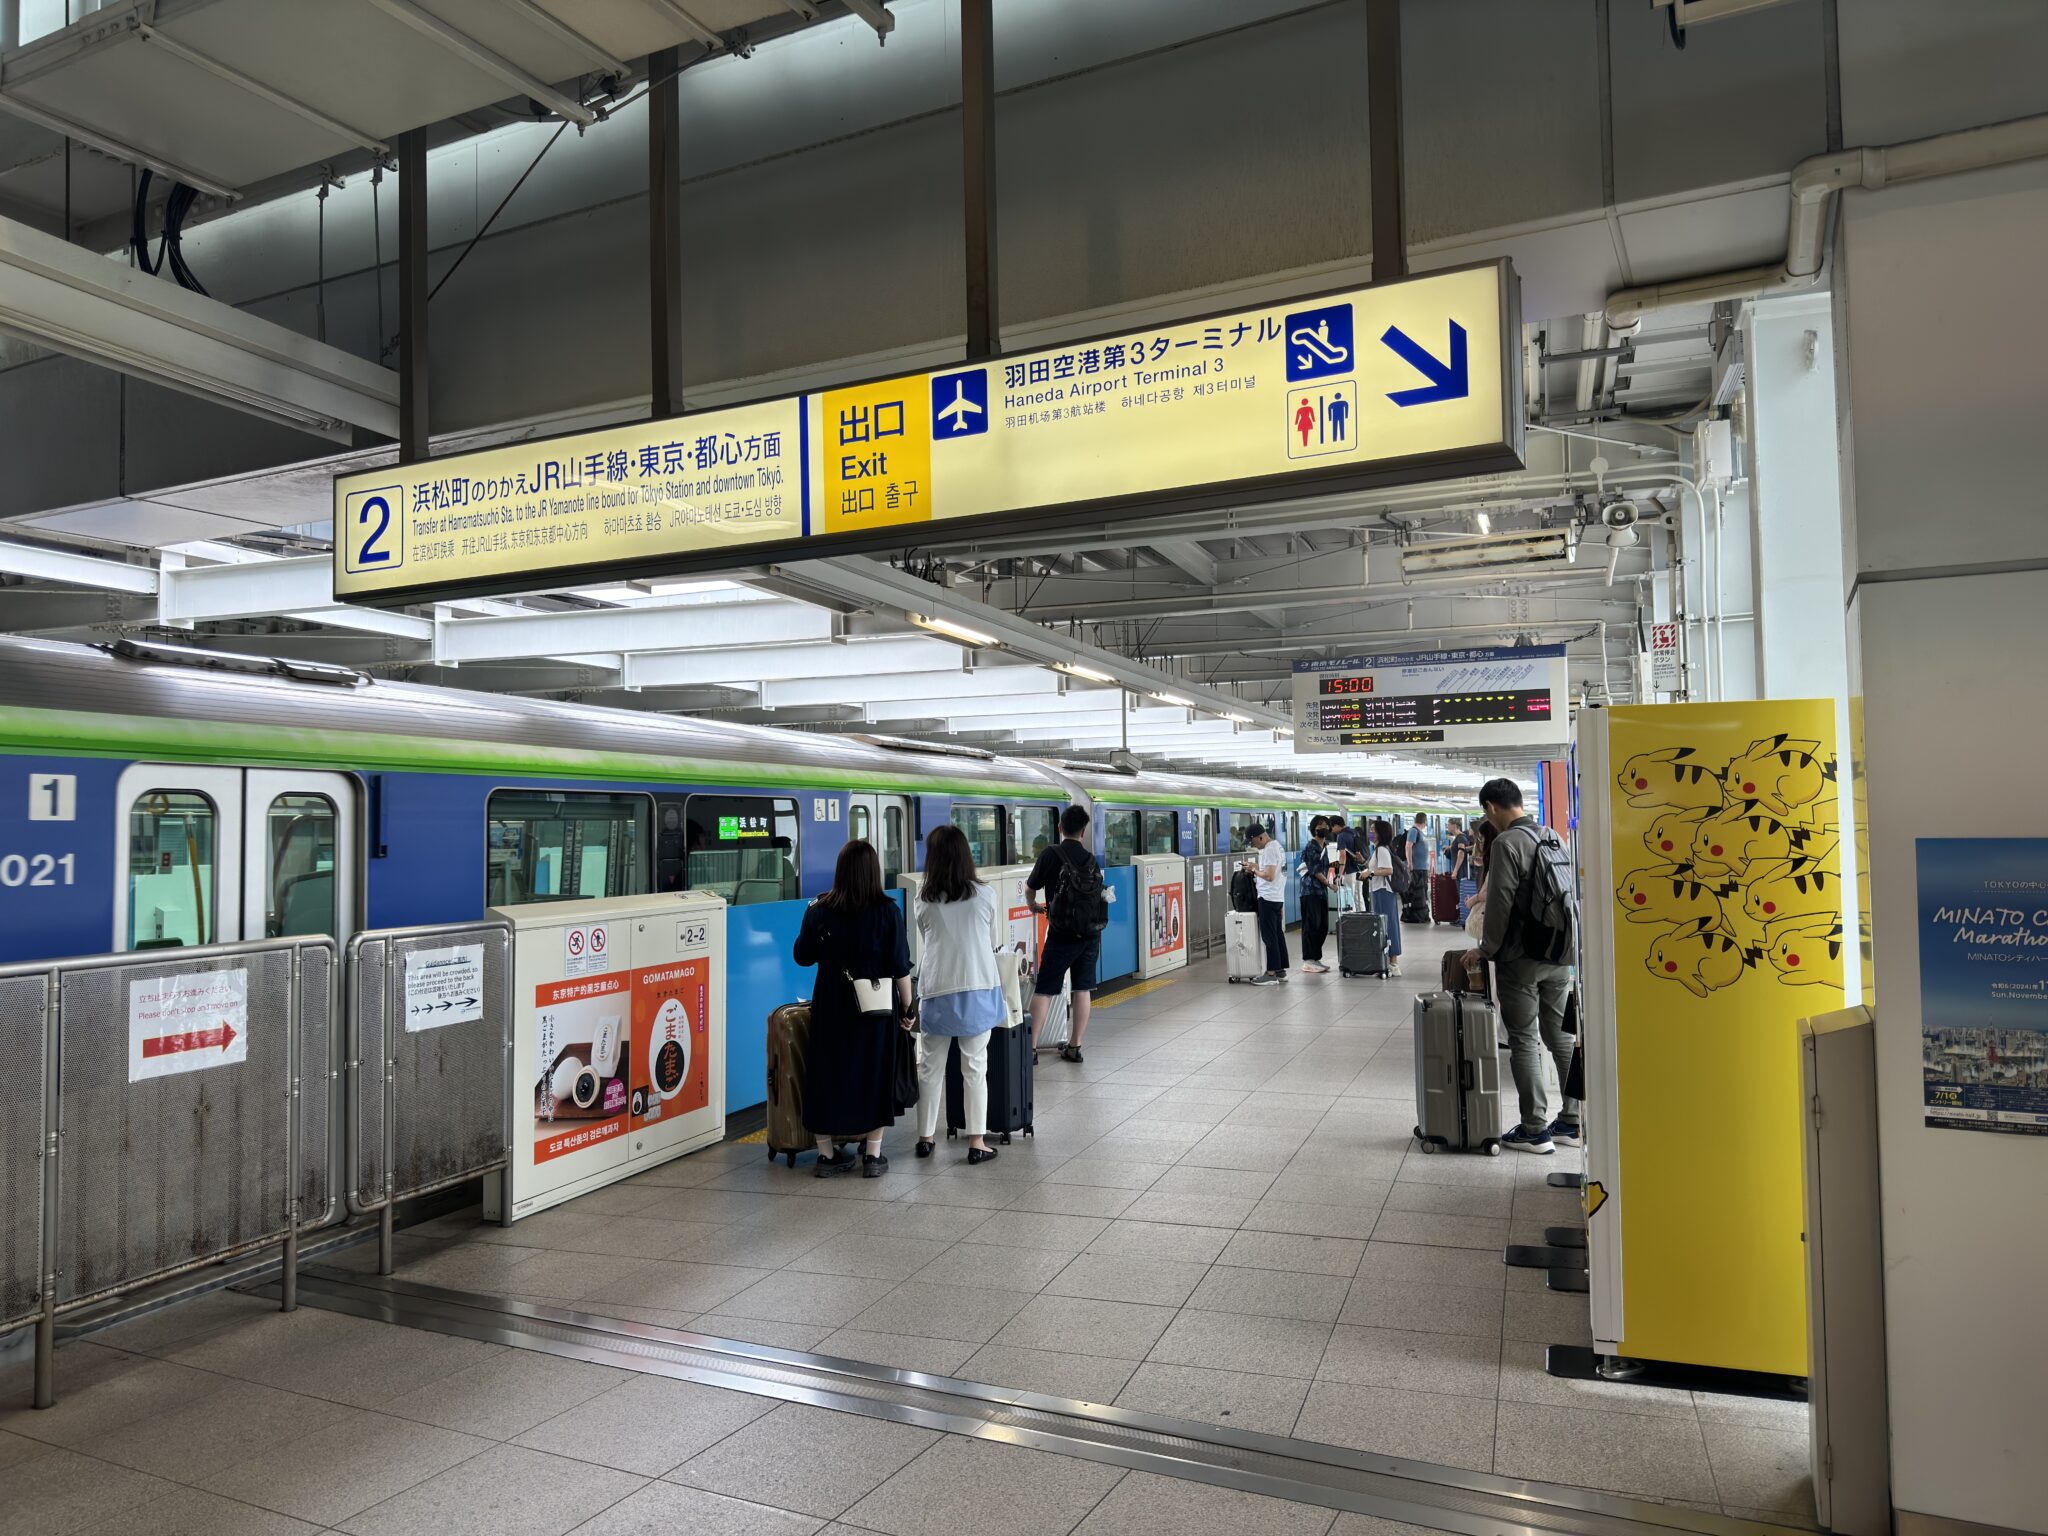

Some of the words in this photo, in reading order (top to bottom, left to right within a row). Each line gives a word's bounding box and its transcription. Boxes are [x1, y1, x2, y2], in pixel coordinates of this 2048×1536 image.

[1004, 316, 1282, 389] 羽田空港第3ターミナル
[1005, 387, 1064, 409] Haneda
[1069, 374, 1127, 399] Airport
[1133, 360, 1207, 386] Terminal
[1213, 358, 1224, 372] 3
[1121, 386, 1185, 409] 하네다공항
[1193, 375, 1256, 397] 제3터미널
[840, 400, 904, 446] 出口
[1005, 400, 1106, 429] 羽田机场第3航站楼
[842, 452, 887, 480] Exit
[413, 517, 438, 537] Transfer
[440, 515, 447, 531] at
[501, 504, 514, 523] Sta.
[516, 505, 523, 521] to
[525, 502, 536, 519] the
[537, 499, 547, 517] JR
[550, 496, 584, 516] Yamanote
[586, 493, 599, 510] line
[601, 489, 626, 508] bound
[628, 487, 638, 505] for
[666, 479, 694, 500] Station
[696, 476, 711, 496] and
[713, 472, 755, 494] downtown
[842, 488, 874, 515] 出口
[885, 480, 918, 509] 출구
[645, 511, 662, 533] 환승
[765, 494, 781, 516] 방향
[359, 496, 390, 564] 2
[1365, 657, 1373, 667] 2
[1328, 677, 1372, 693] 15:00
[41, 779, 58, 816] 1
[830, 801, 836, 819] 1
[1984, 881, 2048, 889] TOKYOの中心
[1933, 906, 2024, 926] MINATO
[2032, 910, 2048, 926] C
[687, 928, 705, 942] 2-2
[408, 981, 425, 989] please
[426, 979, 446, 987] proceed
[643, 967, 695, 985] GOMATAMAGO
[138, 1010, 160, 1020] Please
[162, 1008, 179, 1017] don't
[229, 1000, 238, 1008] on
[664, 1004, 679, 1091] ごまたまご
